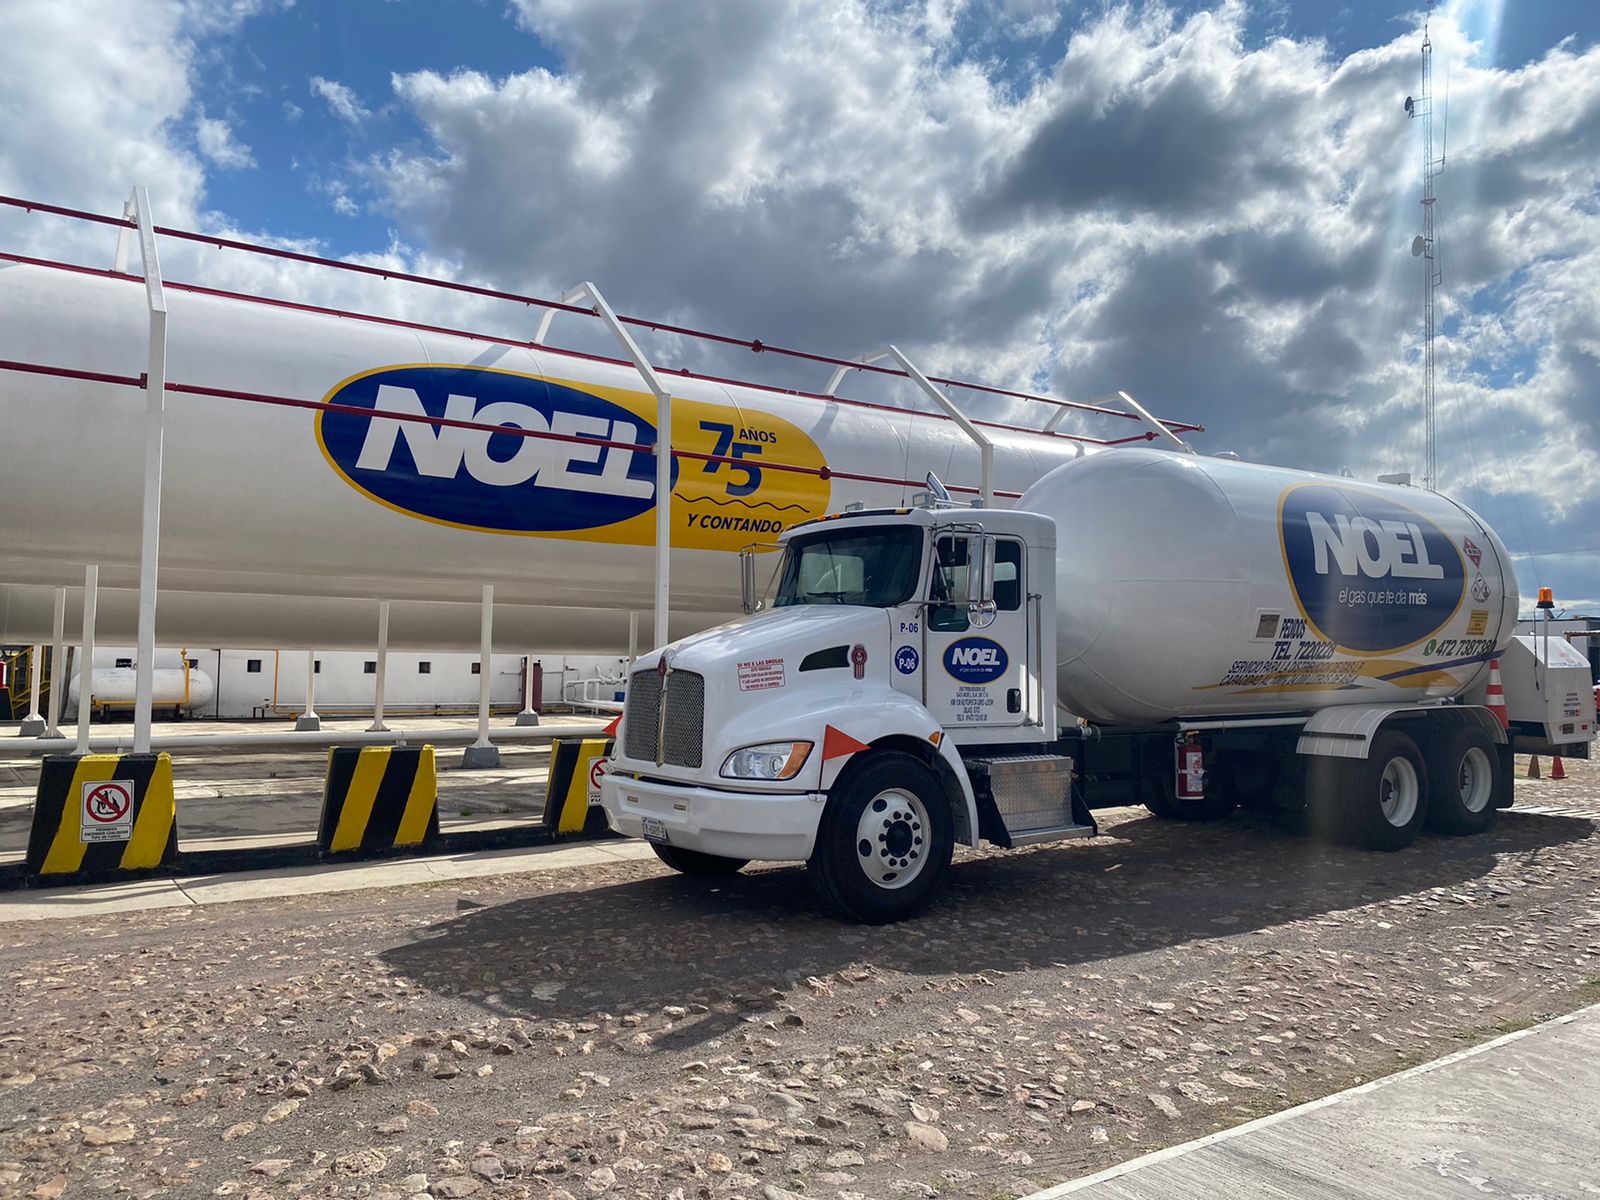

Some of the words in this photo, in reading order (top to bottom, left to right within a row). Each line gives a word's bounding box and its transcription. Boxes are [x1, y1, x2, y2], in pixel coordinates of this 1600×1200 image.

[355, 384, 655, 499] NOEL
[699, 420, 762, 496] 75
[739, 427, 777, 443] AÑOS
[687, 513, 699, 527] Y
[1306, 511, 1445, 579] NOEL
[1339, 586, 1348, 603] el
[1348, 590, 1366, 607] gas
[1367, 591, 1385, 607] que
[1395, 588, 1407, 604] da
[1408, 587, 1428, 605] más
[900, 623, 918, 633] P-06
[952, 648, 1000, 666] NOEL
[1436, 640, 1457, 656] 472
[899, 658, 915, 670] P-06
